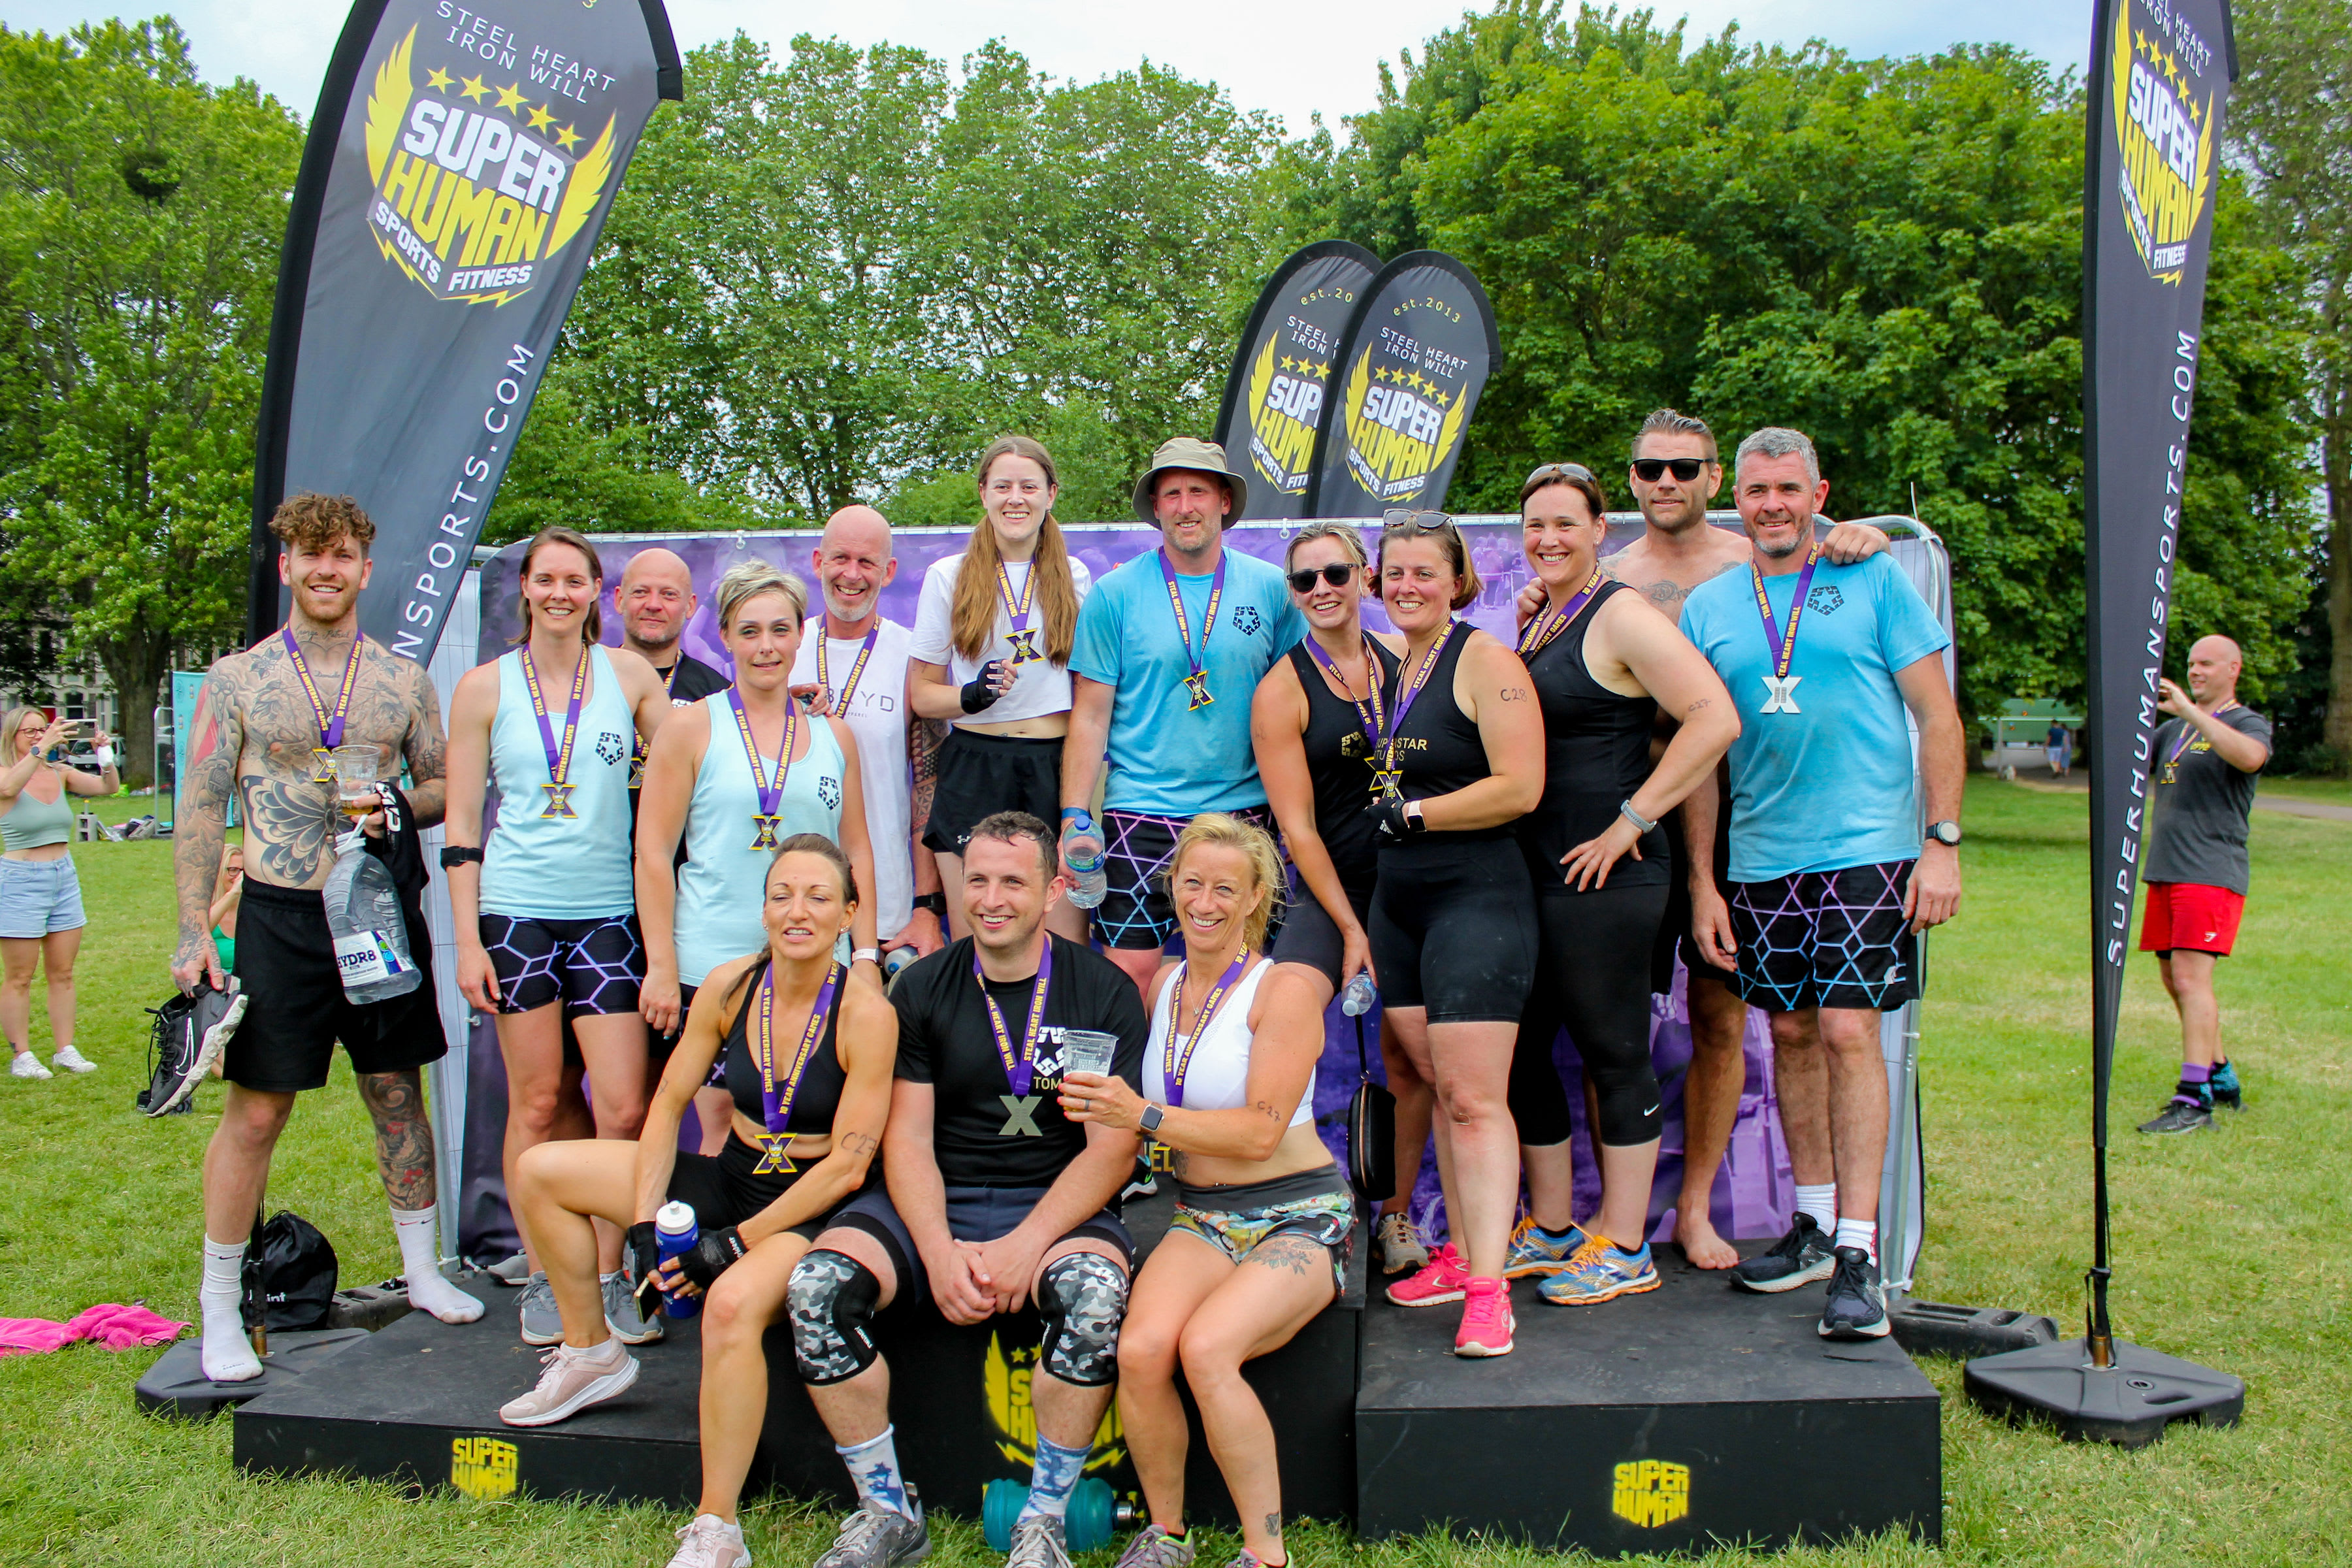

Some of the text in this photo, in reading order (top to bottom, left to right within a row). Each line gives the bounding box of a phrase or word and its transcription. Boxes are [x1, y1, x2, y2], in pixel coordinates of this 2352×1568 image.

[436, 0, 616, 93] STEEL HEART
[2140, 0, 2171, 37] RON
[2175, 32, 2201, 78] WILL
[2175, 12, 2212, 67] HEART
[446, 25, 589, 104] IRON WILL
[2128, 61, 2198, 190] SUPER
[403, 99, 566, 214] SUPER
[2123, 114, 2193, 246] HUMAN
[382, 149, 549, 267] HUMAN
[2121, 169, 2187, 270] SPORTS FITNESS
[375, 201, 533, 291] SPORTS FITNESS
[1300, 287, 1353, 306] est.20
[1392, 297, 1462, 325] est.2013
[1286, 315, 1328, 344] STEEL
[1291, 331, 1327, 355] IRON
[1380, 326, 1469, 372] STEEL HEART
[1384, 340, 1454, 379] IRON WILL
[1267, 374, 1322, 429] SUP
[1362, 385, 1442, 445] SUPER
[1256, 405, 1316, 474] HUM
[1352, 416, 1434, 480] HUMAN
[1252, 437, 1284, 484] SPORTS
[1348, 448, 1426, 497] SPORTS FITNESS
[391, 343, 535, 659] NSPORTS.COM
[1000, 577, 1013, 604] ANNIVERSARY
[1008, 604, 1019, 617] GAMES
[1168, 581, 1178, 598] STEAL
[1582, 585, 1591, 595] 10
[1588, 572, 1600, 589] YEAR
[1172, 597, 1183, 616] HEART
[1178, 615, 1186, 632] IRON
[1204, 615, 1214, 635] HEART
[1212, 589, 1220, 604] WILL
[1550, 613, 1567, 633] GAMES
[1761, 602, 1772, 619] WILL
[1791, 606, 1801, 622] WILL
[1516, 621, 1541, 656] ANNIVERSARY
[1787, 621, 1797, 638] IRON
[353, 640, 362, 659] GAMES
[818, 646, 827, 683] ANNIVERSARY
[1413, 623, 1454, 689] STEAL HEART IRON WILL
[1782, 637, 1793, 660] HEART
[2107, 330, 2196, 967] SUPERHUMANSPORTS.COM
[342, 658, 358, 695] ANNIVERSARY
[523, 649, 545, 717] STEAL HEART IRON WILL
[574, 677, 583, 693] YEAR
[841, 664, 862, 703] ANNIVERSARY
[857, 648, 869, 666] GAMES
[1778, 659, 1788, 677] TEAL
[294, 657, 307, 672] YEAR
[301, 671, 323, 711] ANNIVERSARY
[318, 710, 329, 731] GAMES
[338, 694, 348, 710] YEAR
[828, 688, 894, 712] BYD
[1369, 675, 1384, 714] ANNIVERSARY
[1500, 688, 1527, 702] C28
[738, 715, 748, 730] YEAR
[1365, 716, 1372, 725] 10
[1376, 713, 1384, 734] GAME
[555, 724, 575, 783] NNIVERSARY GAMES
[742, 729, 760, 769] ANNIVERSARY
[779, 730, 793, 769] ANNIVERSARY
[754, 768, 766, 789] GAMES
[776, 768, 786, 784] YEAR
[826, 962, 839, 985] 10 YEA
[1235, 954, 1245, 964] 10
[991, 1011, 1005, 1037] HEART
[1023, 977, 1047, 1062] STEAL HEART IRON WILL
[1168, 1000, 1179, 1049] ANNIVERSARY
[1175, 987, 1224, 1086] 10 YEAR ANNIVERSARY GAMES
[762, 987, 773, 1093] 10 YEAR ANNIVERSARY GAMES
[997, 1035, 1010, 1054] IRON
[779, 1013, 821, 1115] 10 YEAR ANNIVERSARY GAMES
[1003, 1052, 1016, 1071] WILL
[1033, 1076, 1062, 1090] TOM
[1320, 1222, 1337, 1241] Reebok
[452, 1437, 518, 1470] SUPER
[451, 1463, 516, 1499] HUMAN
[1613, 1458, 1690, 1492] SUPER
[1612, 1489, 1690, 1529] HUMAN
